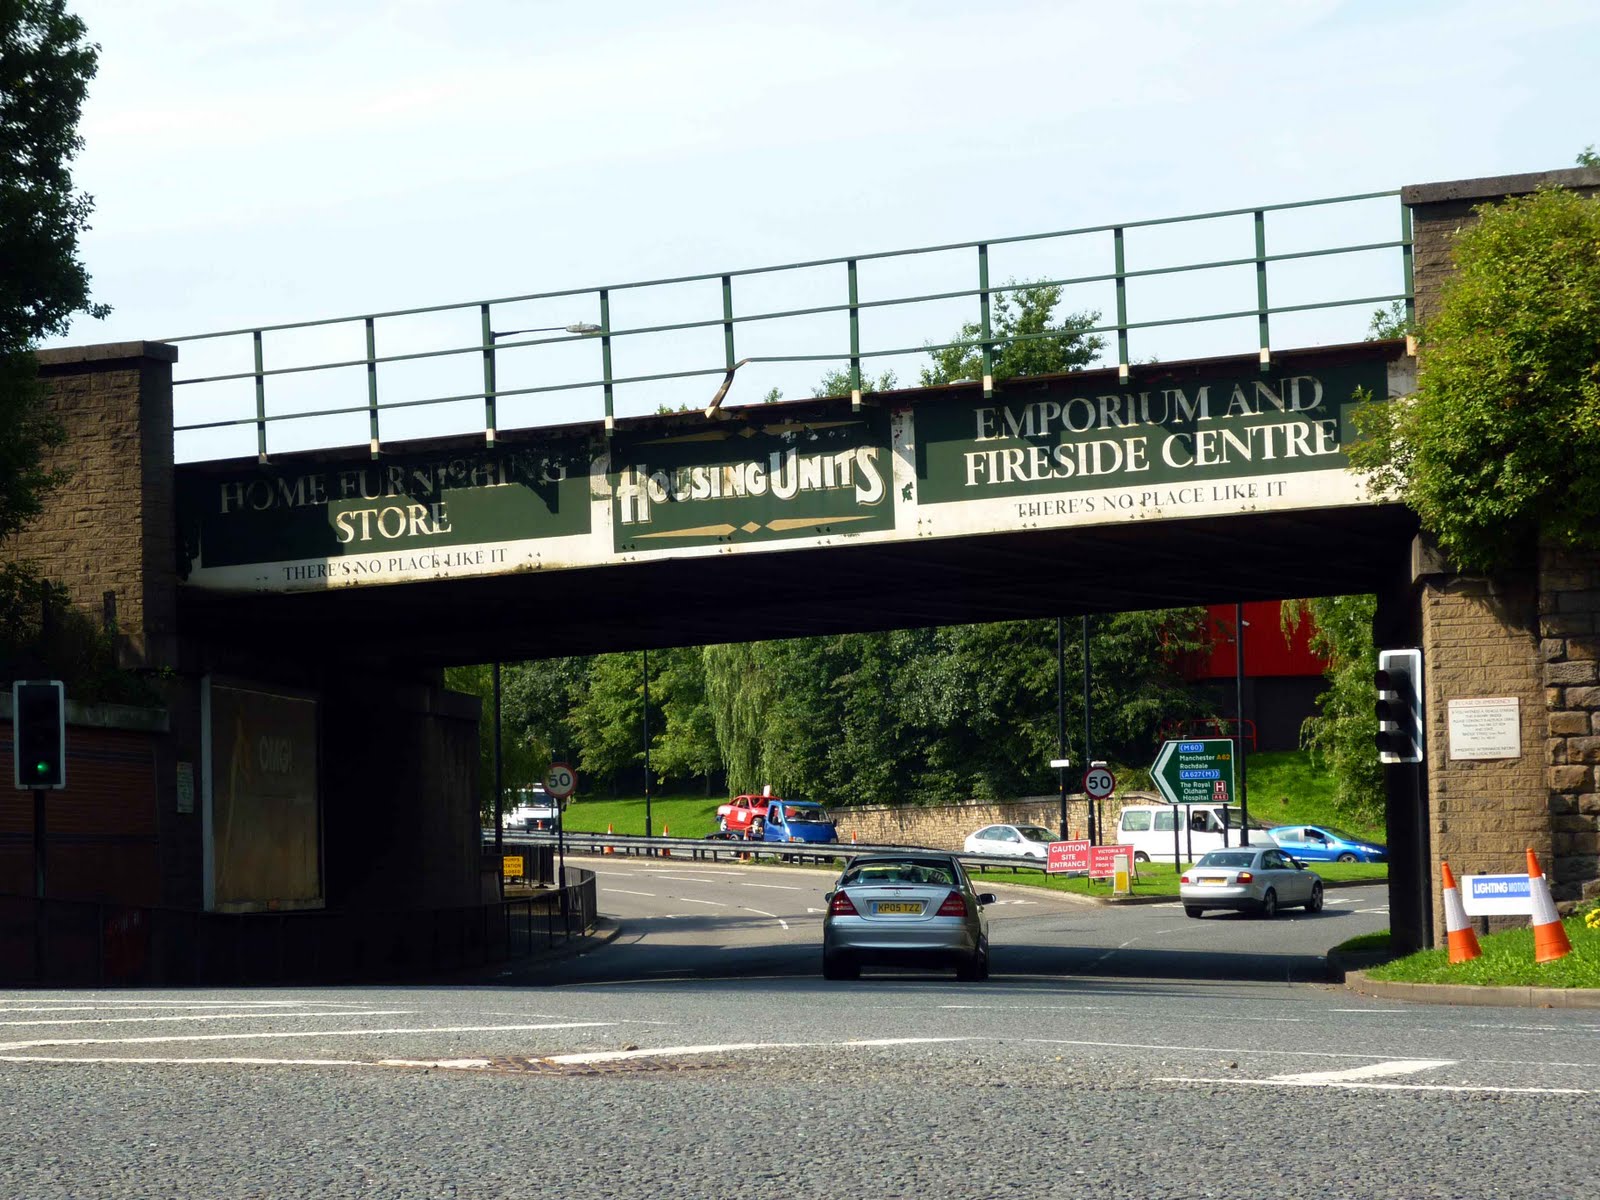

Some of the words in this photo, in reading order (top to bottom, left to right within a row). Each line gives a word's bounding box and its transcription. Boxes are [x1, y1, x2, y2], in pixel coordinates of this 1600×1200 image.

[973, 384, 1212, 442] EMPORIUM
[1224, 375, 1324, 419] AND
[964, 436, 1150, 487] FIRESIDE
[1162, 418, 1340, 468] CENTRE
[219, 473, 328, 515] HOME
[338, 457, 567, 502] FURNISHIG
[616, 462, 769, 524] HOUSING
[769, 446, 887, 507] UNITS
[1014, 496, 1095, 518] THERE'S
[1102, 494, 1133, 511] NO
[1141, 487, 1205, 508] PLACE
[1213, 483, 1258, 503] LIKE
[1267, 481, 1288, 498] IT
[336, 501, 452, 544] STORE
[283, 561, 350, 580] THERE'S
[355, 561, 382, 576] NO
[389, 554, 440, 572] PLACE
[447, 550, 484, 568] LIKE
[491, 548, 508, 563] IT
[549, 772, 571, 788] 50
[1088, 775, 1111, 790] 50
[1215, 782, 1225, 792] H
[1051, 844, 1087, 853] CAUTION
[1050, 860, 1086, 869] ENTRANCE
[1474, 881, 1508, 894] LIGHTING
[878, 903, 901, 912] KP05
[903, 903, 920, 912] TZZ
